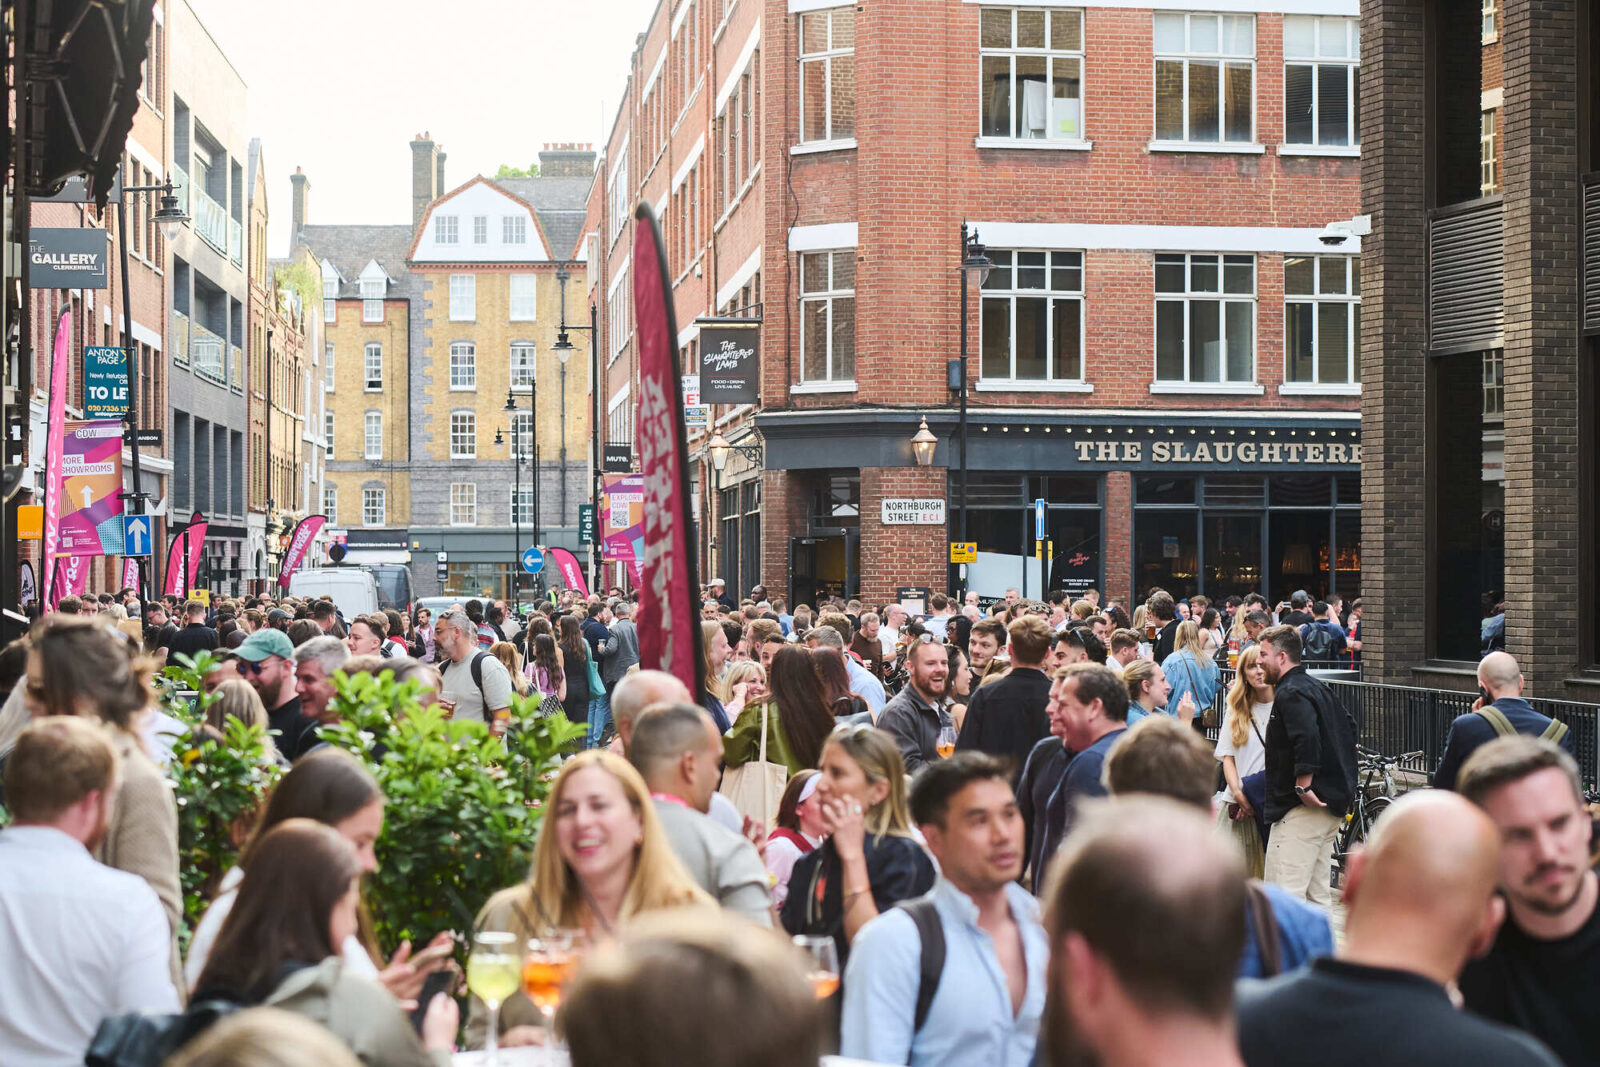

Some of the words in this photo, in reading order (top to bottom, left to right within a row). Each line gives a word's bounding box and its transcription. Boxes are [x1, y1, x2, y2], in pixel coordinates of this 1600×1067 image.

[31, 253, 97, 265] GALLERY
[720, 340, 736, 351] THE
[87, 348, 119, 357] ANTON
[703, 349, 754, 365] SLAUGHTERED
[97, 356, 119, 365] PAGE
[715, 360, 738, 372] LAMB
[88, 386, 109, 400] TO
[76, 429, 97, 438] CDW
[1075, 441, 1142, 462] THE
[1152, 441, 1362, 464] SLAUGHTERE
[62, 464, 112, 474] SHOWROOMS
[885, 501, 942, 511] NORTHBURGH
[887, 513, 919, 522] STREET
